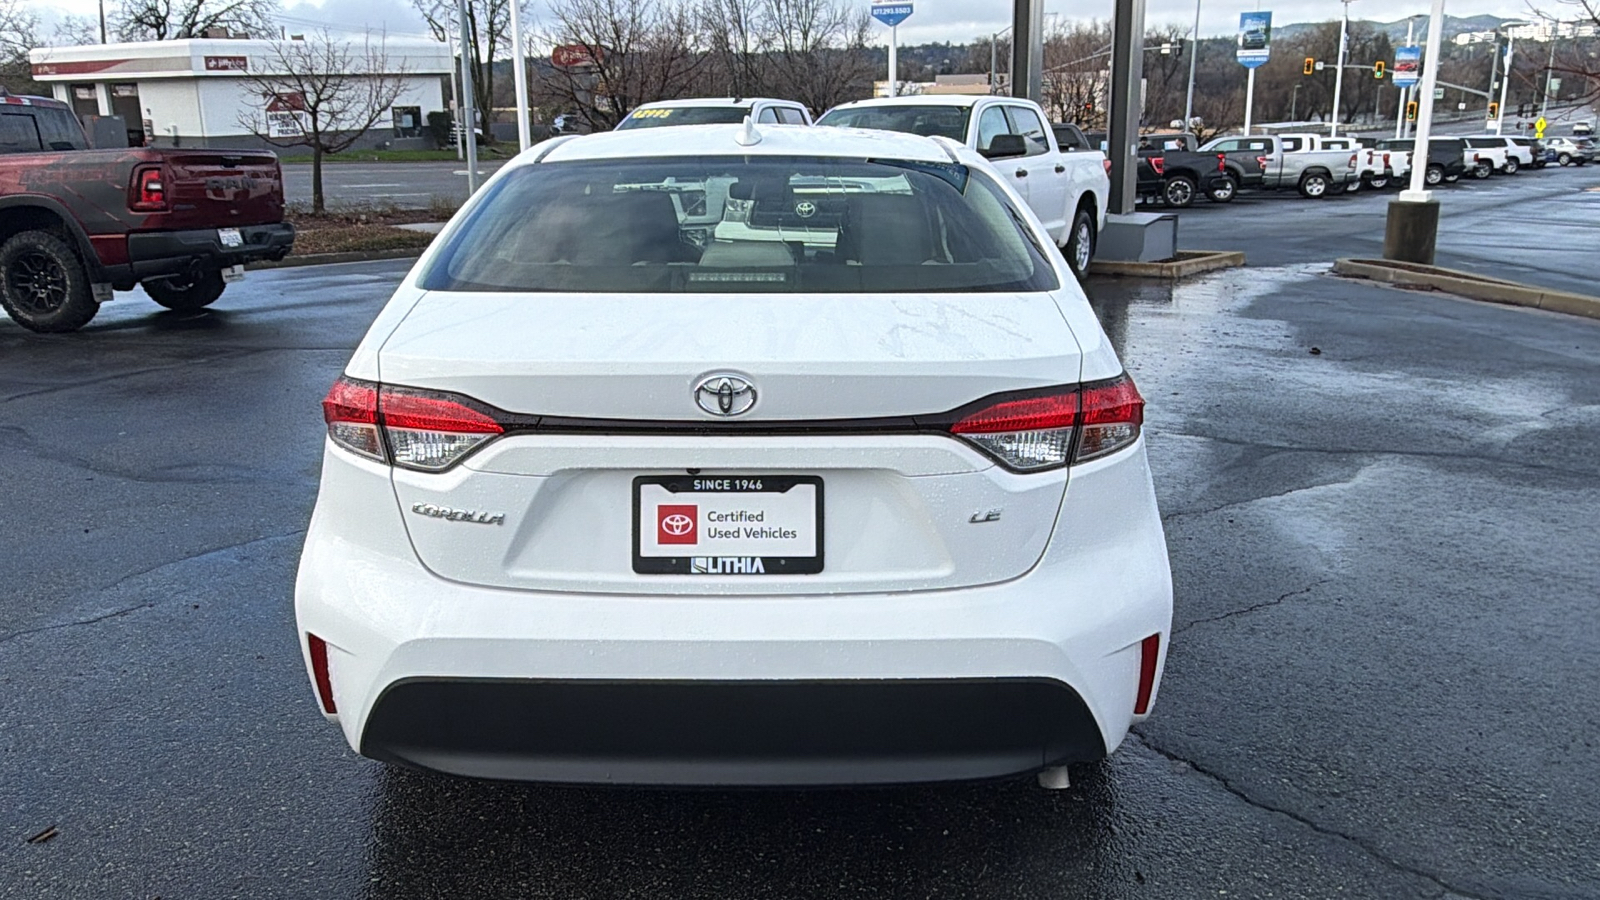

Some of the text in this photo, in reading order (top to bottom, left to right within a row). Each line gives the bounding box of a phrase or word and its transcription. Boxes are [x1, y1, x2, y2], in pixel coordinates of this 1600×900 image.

[873, 7, 911, 15] 877.293.5503
[206, 177, 258, 190] RAM
[693, 479, 763, 490] SINCE 1946
[412, 502, 505, 525] COROLLA
[707, 510, 765, 522] Certified
[968, 508, 1003, 523] LE
[707, 527, 797, 539] Used Vehicles
[706, 557, 765, 573] LITHIA
